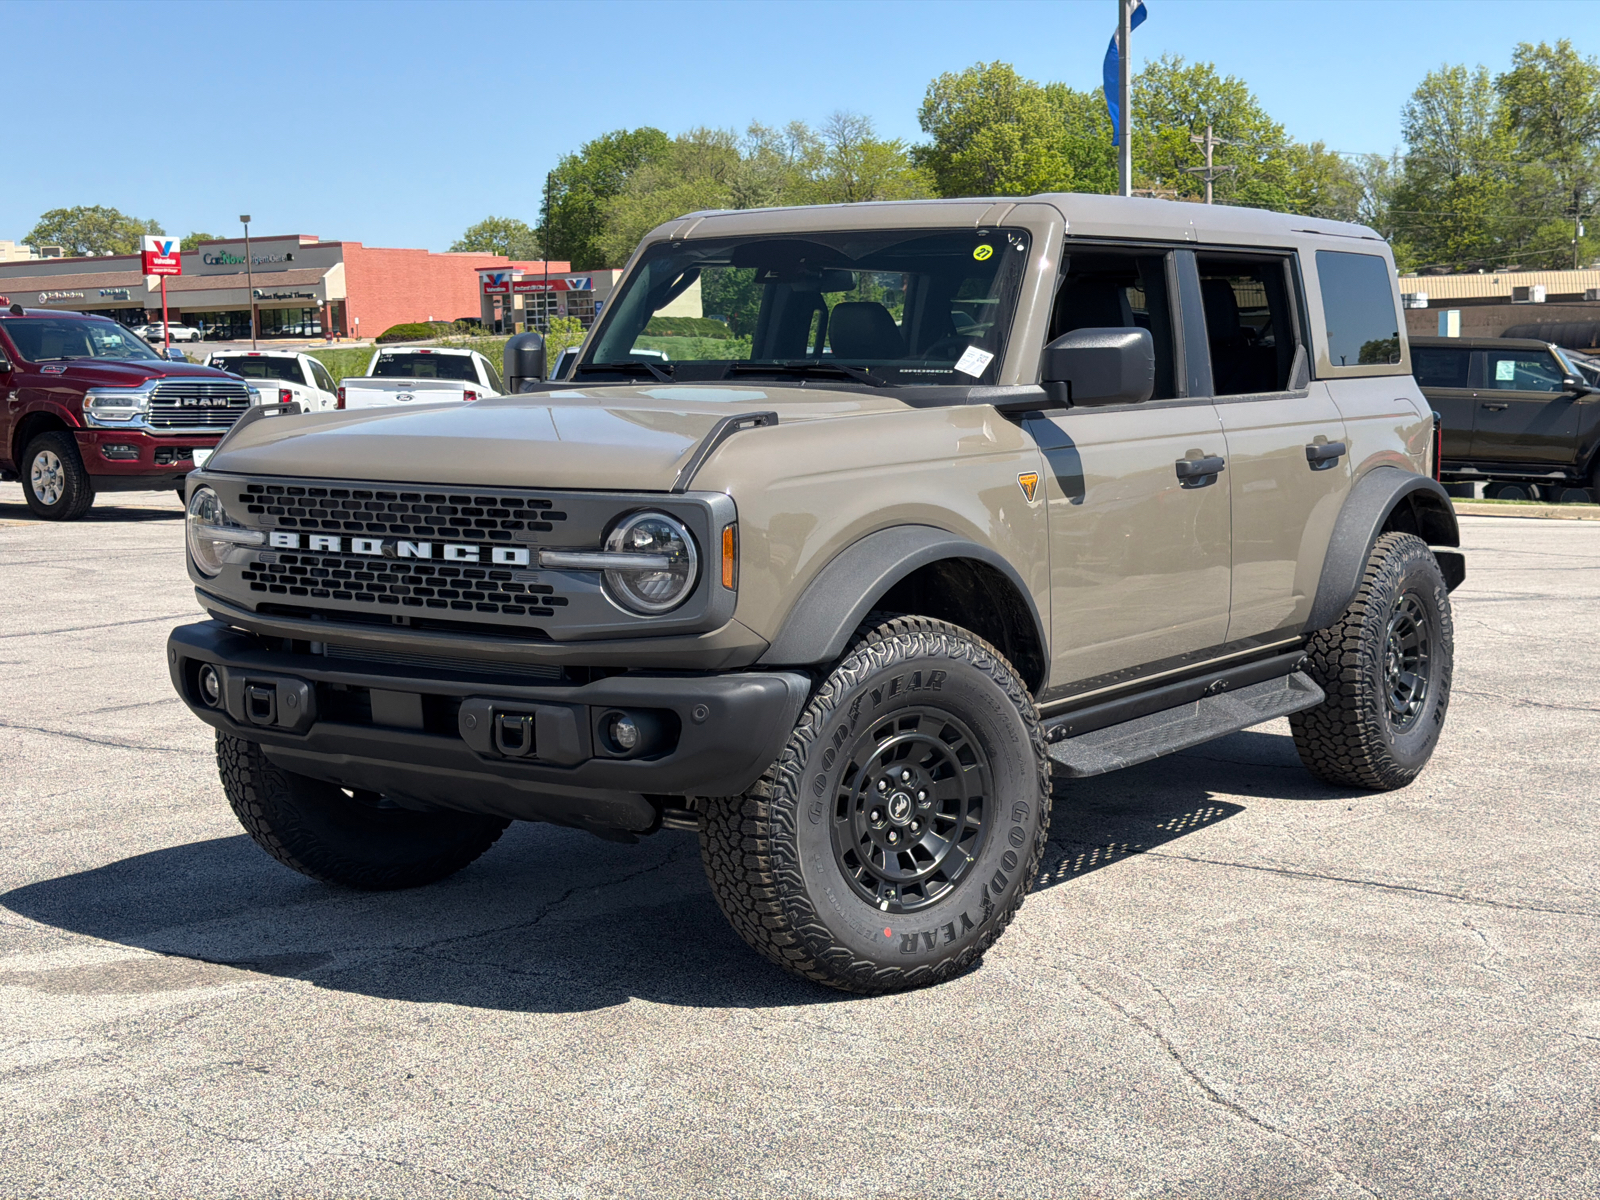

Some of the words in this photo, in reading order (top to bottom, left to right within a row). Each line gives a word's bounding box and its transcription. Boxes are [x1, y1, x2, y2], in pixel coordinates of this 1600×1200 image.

[976, 248, 991, 259] 27
[183, 398, 227, 406] RAM
[269, 531, 530, 566] BRONCO
